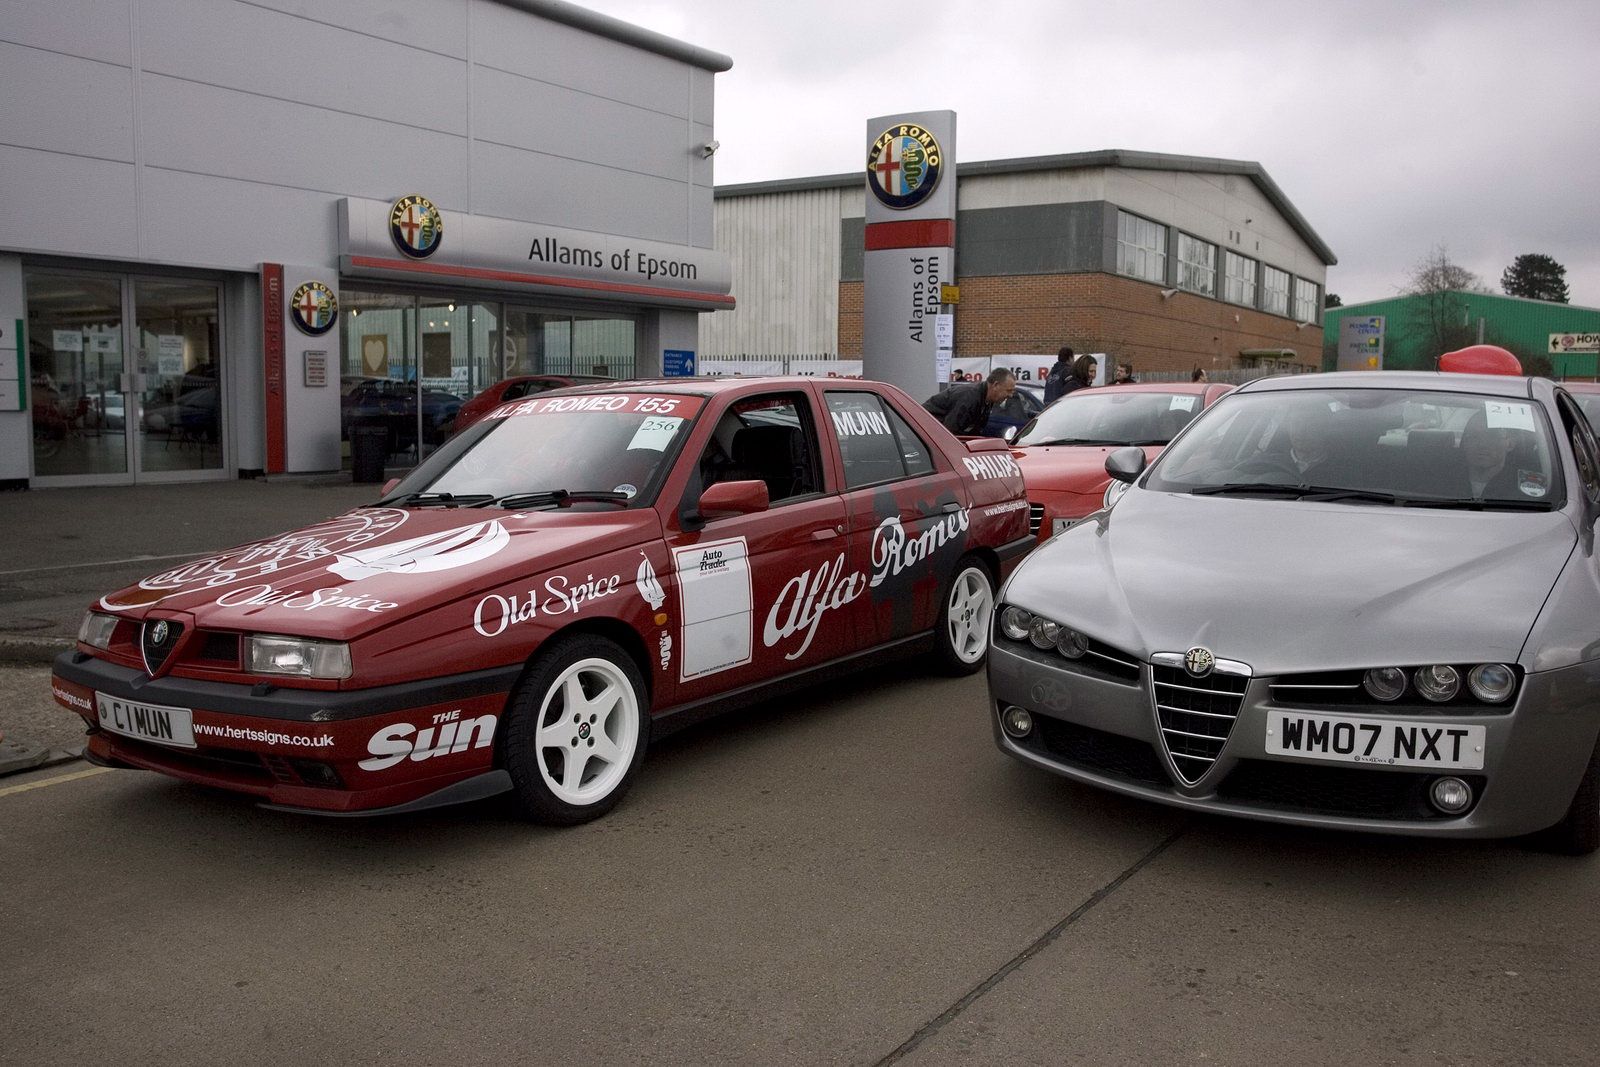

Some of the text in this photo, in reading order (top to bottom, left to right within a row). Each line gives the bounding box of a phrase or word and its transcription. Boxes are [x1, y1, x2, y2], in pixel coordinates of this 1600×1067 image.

[868, 126, 939, 171] ALFA ROMEO
[392, 196, 442, 233] ALFA ROMEO
[528, 237, 697, 280] Allams of Epsom
[292, 282, 338, 312] ALFA ROMEO
[909, 257, 924, 343] Allams of
[925, 256, 941, 315] Epsom
[484, 396, 681, 421] ALFA ROMEO 155
[831, 411, 892, 435] MUNN
[1491, 404, 1526, 416] 211
[641, 420, 676, 432] 256
[962, 454, 1020, 480] PHILIPS
[700, 559, 728, 571] Trader
[702, 550, 723, 561] Auto
[763, 502, 973, 661] Alfa Romeo
[216, 584, 398, 613] Old Spice
[473, 573, 621, 637] Old Spice
[432, 709, 461, 724] THE
[192, 723, 335, 747] www.hertssigns.co.uk
[357, 714, 498, 771] Sun
[1282, 717, 1469, 762] WM07 NXT
